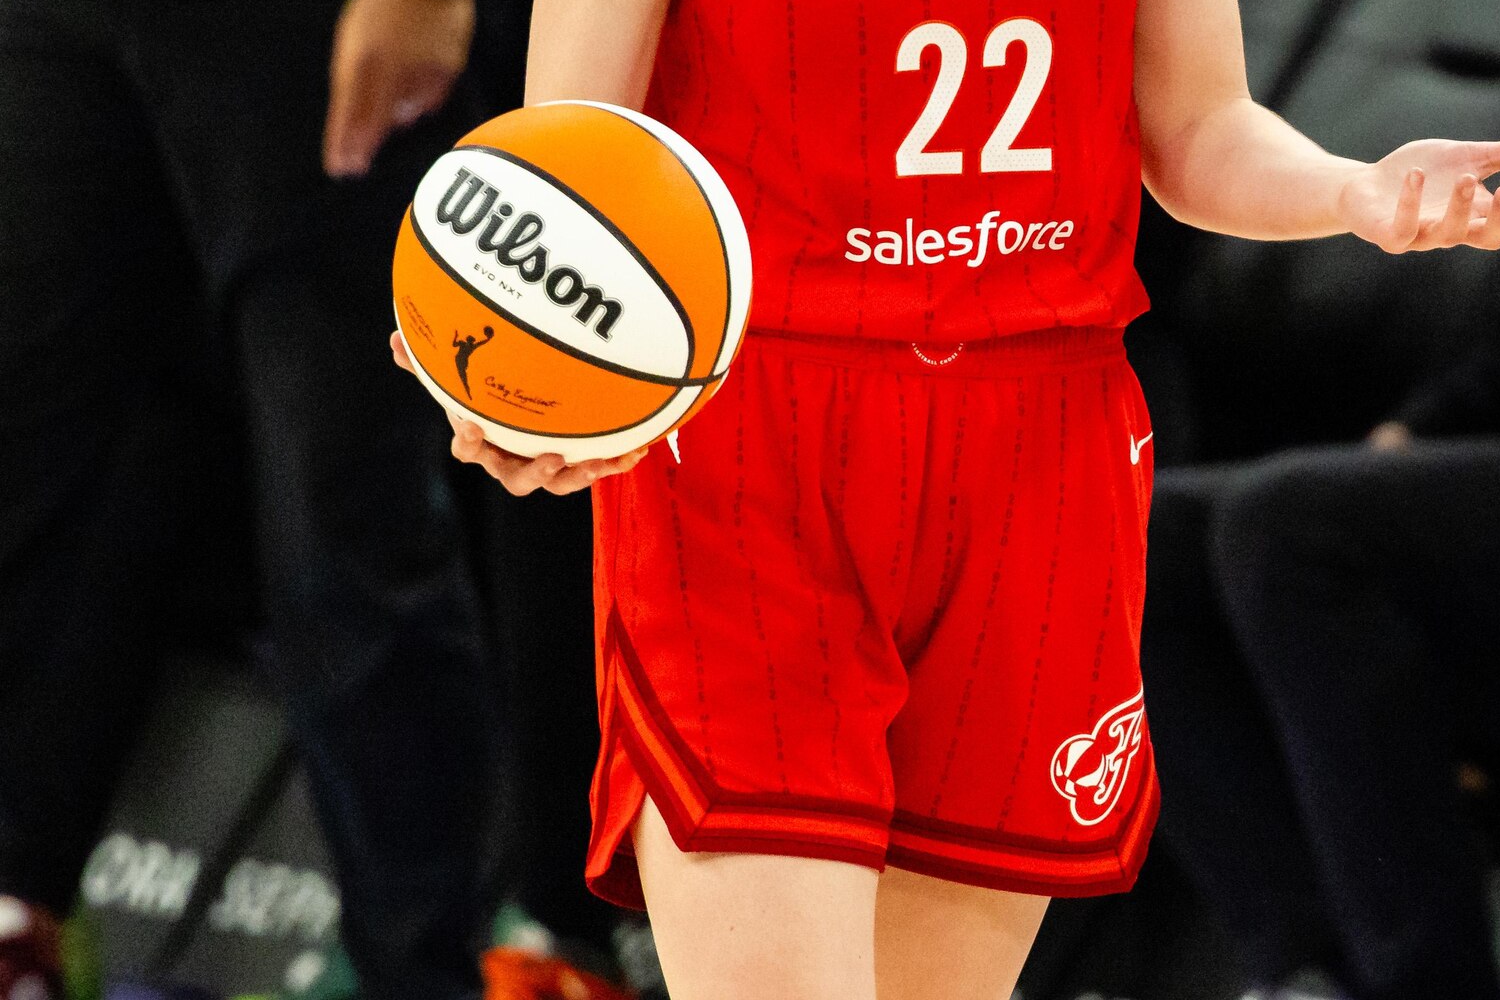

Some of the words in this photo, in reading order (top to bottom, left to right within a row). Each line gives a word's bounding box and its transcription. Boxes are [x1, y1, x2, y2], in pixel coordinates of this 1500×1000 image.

[893, 16, 1053, 178] 22
[435, 166, 625, 343] Wilson
[473, 262, 496, 282] EVO
[499, 280, 523, 300] NXT
[844, 210, 1075, 267] salesforce
